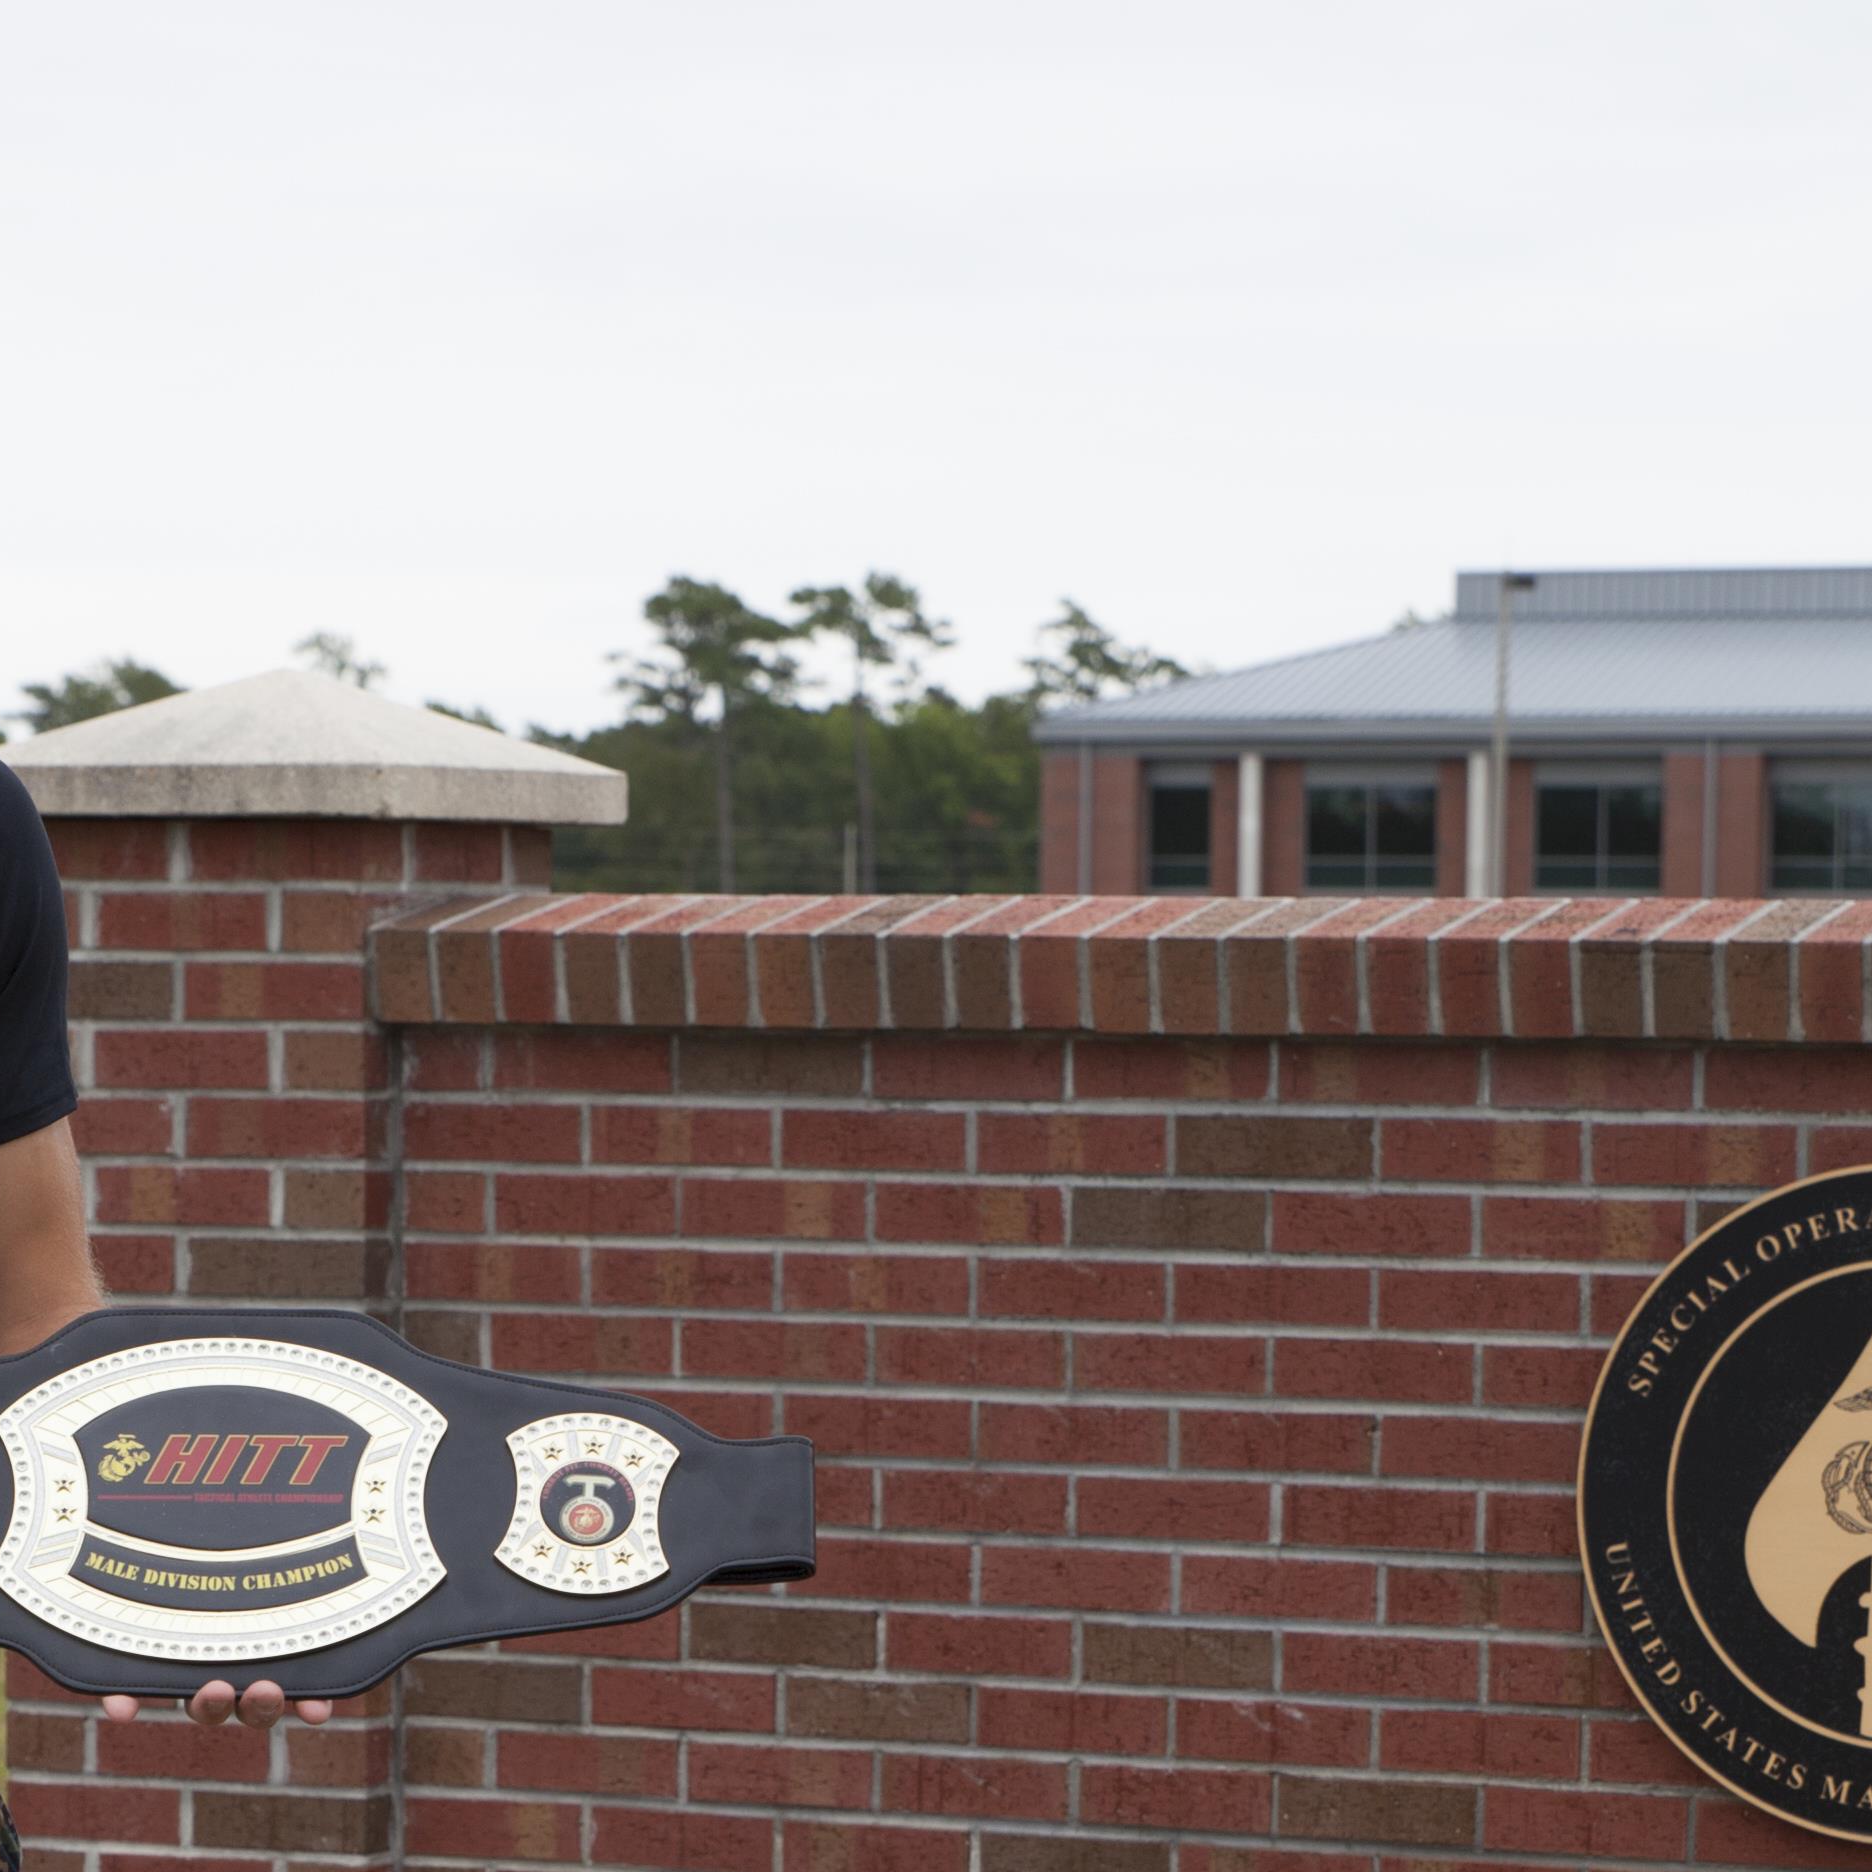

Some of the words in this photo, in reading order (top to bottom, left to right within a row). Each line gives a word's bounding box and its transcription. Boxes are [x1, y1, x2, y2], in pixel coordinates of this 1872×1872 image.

[1628, 1252, 1750, 1398] SPECIAL
[143, 1434, 349, 1485] HITT
[85, 1552, 140, 1582] MALE
[144, 1569, 236, 1592] DIVISION
[242, 1553, 354, 1591] CHAMPION
[1605, 1541, 1684, 1688] UNITED
[1679, 1689, 1808, 1792] STATES
